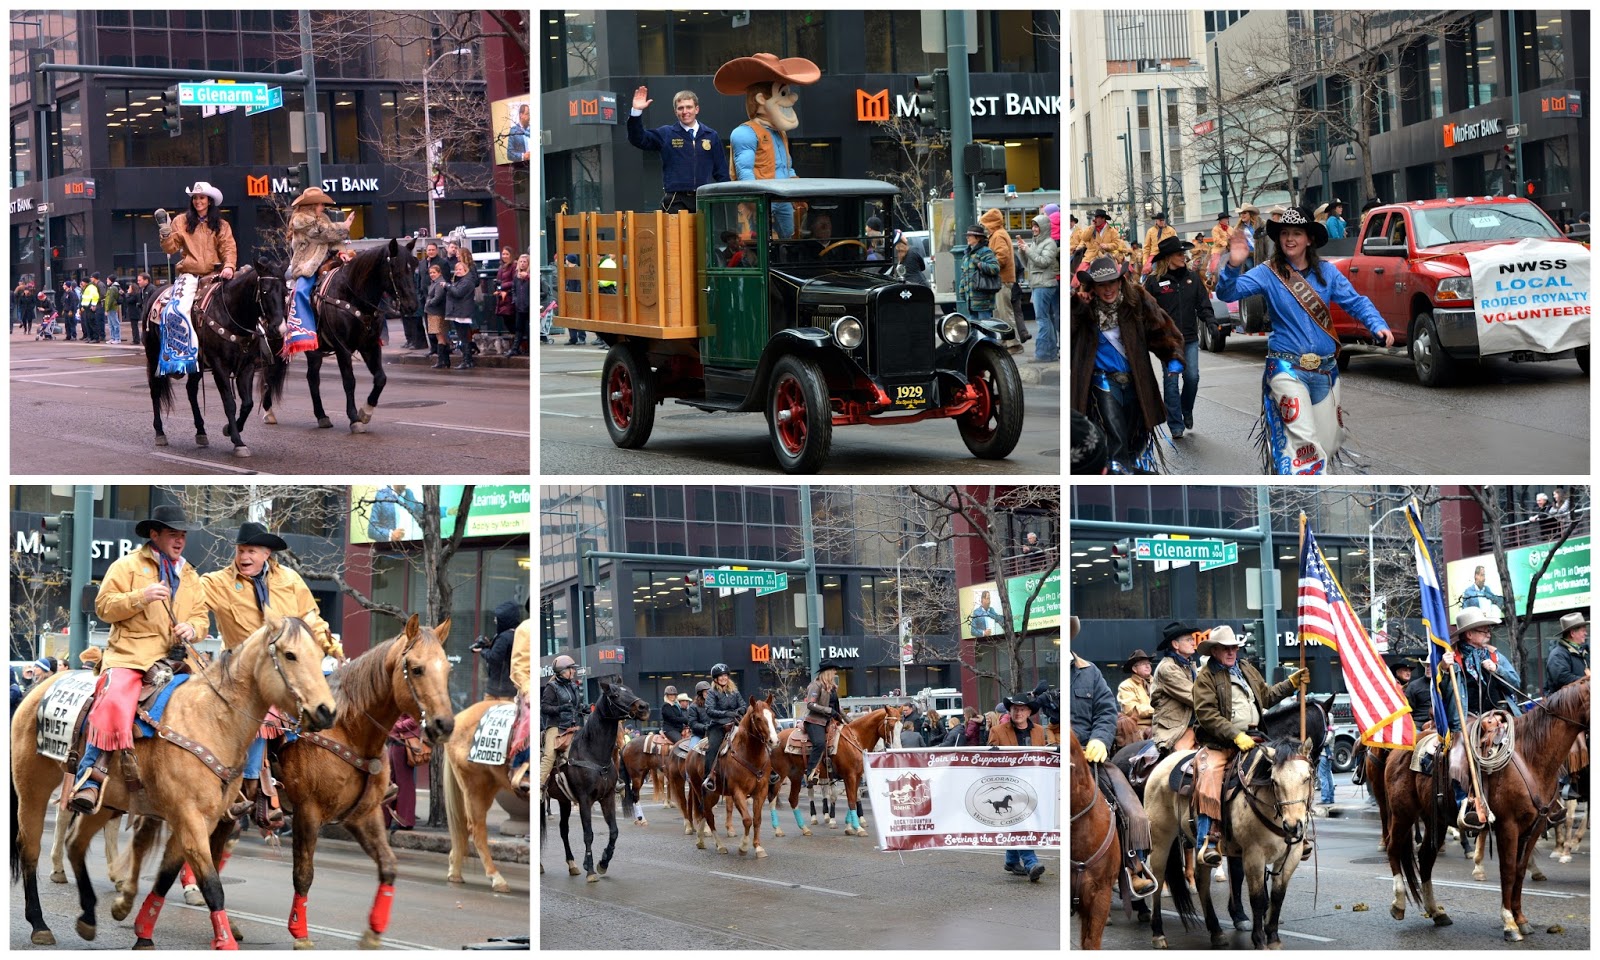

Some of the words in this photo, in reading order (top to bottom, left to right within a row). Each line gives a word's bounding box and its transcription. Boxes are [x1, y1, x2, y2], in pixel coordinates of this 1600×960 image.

[197, 88, 253, 102] Glenarm
[1453, 123, 1481, 143] MIDFIRST
[1481, 118, 1500, 137] BANK
[341, 176, 379, 192] BANK
[1499, 259, 1568, 274] NWSS
[1495, 276, 1573, 291] LOCAL
[1292, 281, 1330, 329] QUEEN
[1481, 295, 1527, 309] RODEO
[1531, 292, 1588, 304] ROYALTY
[1483, 305, 1590, 324] VOLUNTEERS
[896, 386, 924, 398] 1929
[473, 491, 507, 508] Learning,
[1154, 543, 1210, 558] Glenarm
[718, 573, 764, 585] Glenarm
[829, 646, 859, 658] BANK
[51, 689, 84, 707] PEAK
[53, 707, 68, 718] OR
[45, 718, 68, 736] BUST
[487, 716, 509, 728] PEAK
[488, 729, 499, 737] OR
[480, 737, 503, 749] BUST
[476, 750, 502, 762] RODEO
[928, 754, 948, 766] Join
[971, 754, 1016, 767] Supporting
[1018, 754, 1046, 764] Horses
[981, 776, 1020, 784] COLORADO
[973, 812, 996, 826] HORSE
[944, 834, 979, 846] Serving
[980, 834, 993, 843] the
[995, 832, 1037, 844] Colorado
